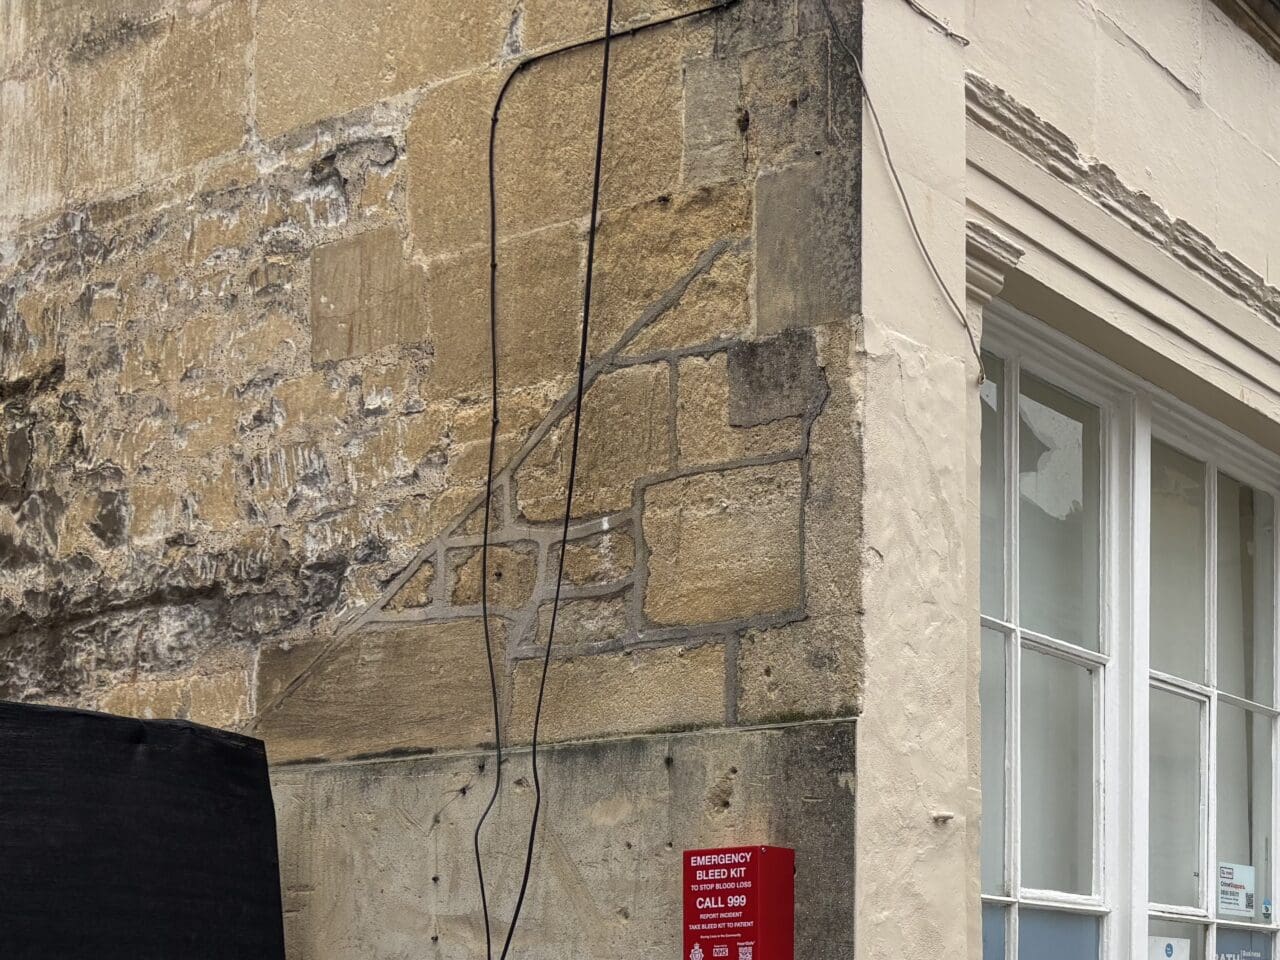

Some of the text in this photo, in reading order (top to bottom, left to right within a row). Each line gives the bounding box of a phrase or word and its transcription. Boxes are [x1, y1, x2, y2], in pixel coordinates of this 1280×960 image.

[690, 852, 752, 867] EMERGENCY
[696, 867, 747, 881] BLEED KIT
[700, 883, 715, 891] STOP
[715, 882, 736, 890] BLOOD
[736, 880, 752, 888] LOSS
[695, 894, 747, 909] CALL 999
[701, 922, 718, 930] BLEED
